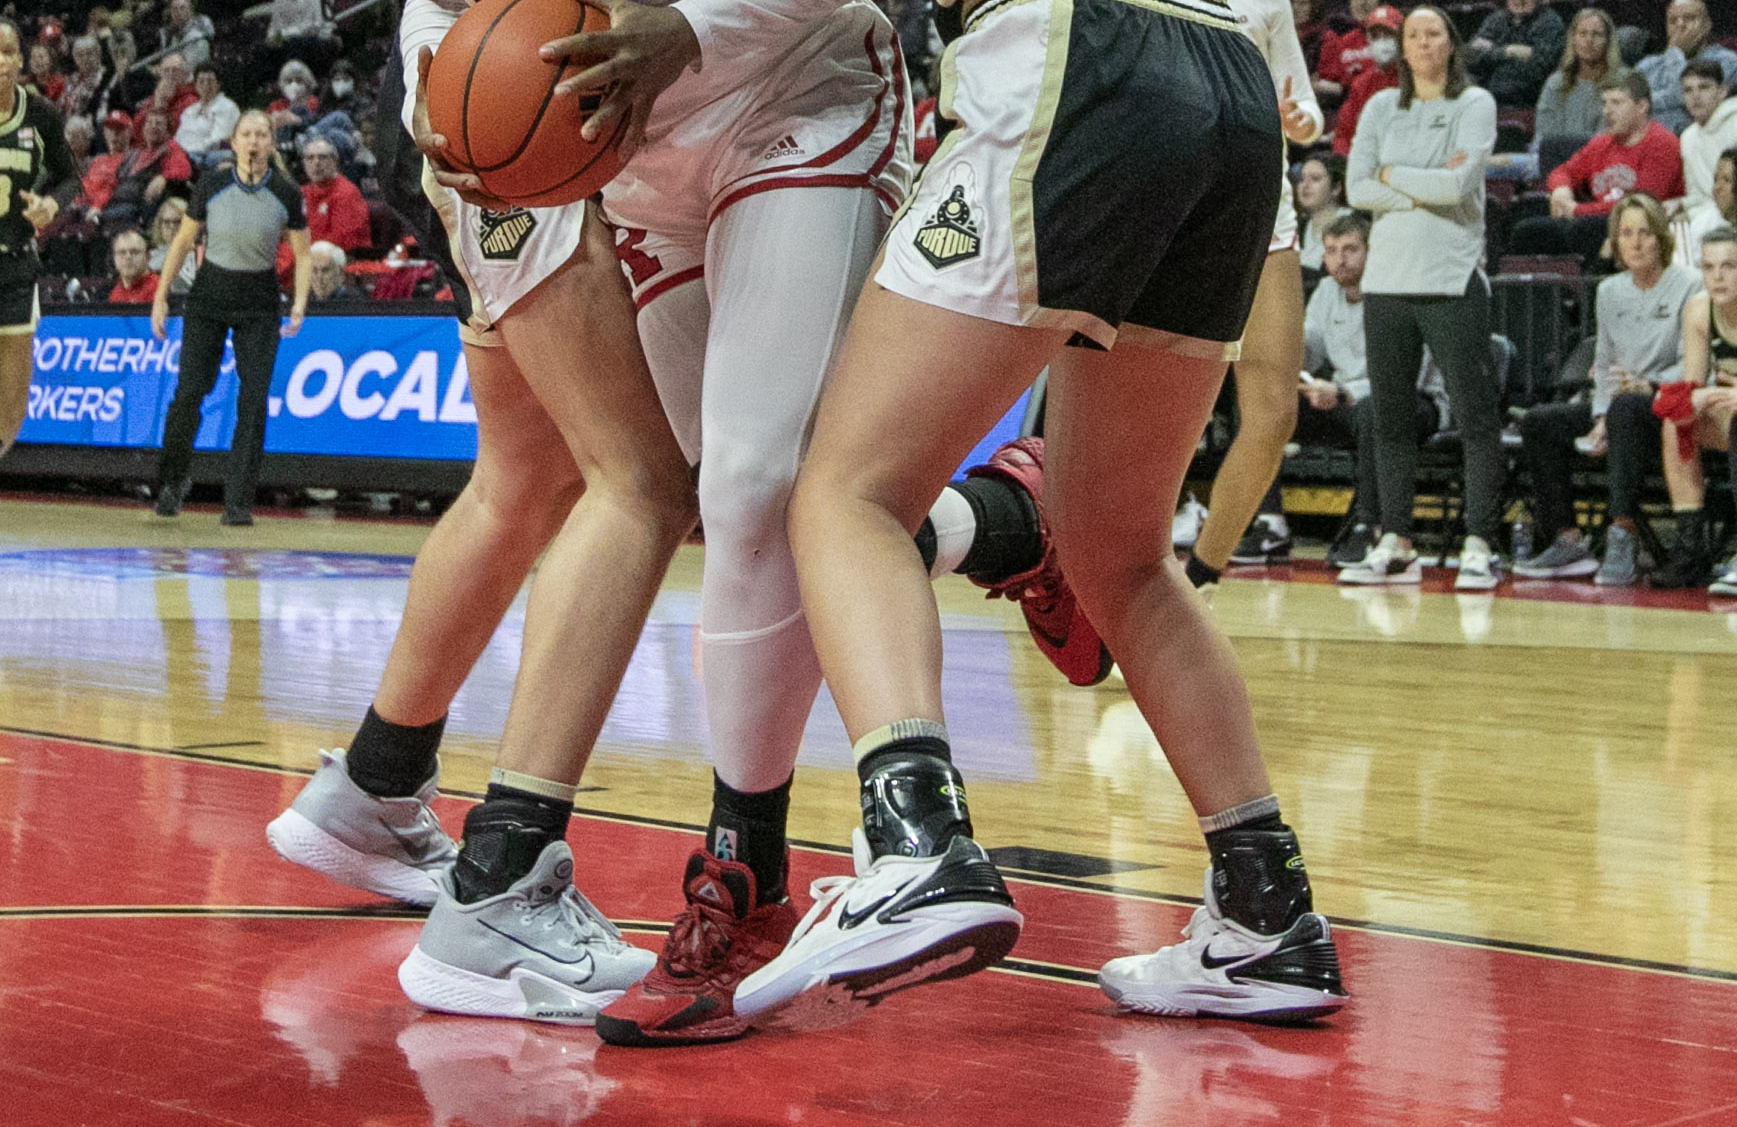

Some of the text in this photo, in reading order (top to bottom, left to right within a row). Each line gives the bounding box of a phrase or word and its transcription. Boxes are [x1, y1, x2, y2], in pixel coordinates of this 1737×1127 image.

[765, 147, 805, 160] adidas
[482, 214, 533, 254] PURDUE
[917, 227, 977, 258] PURDUE
